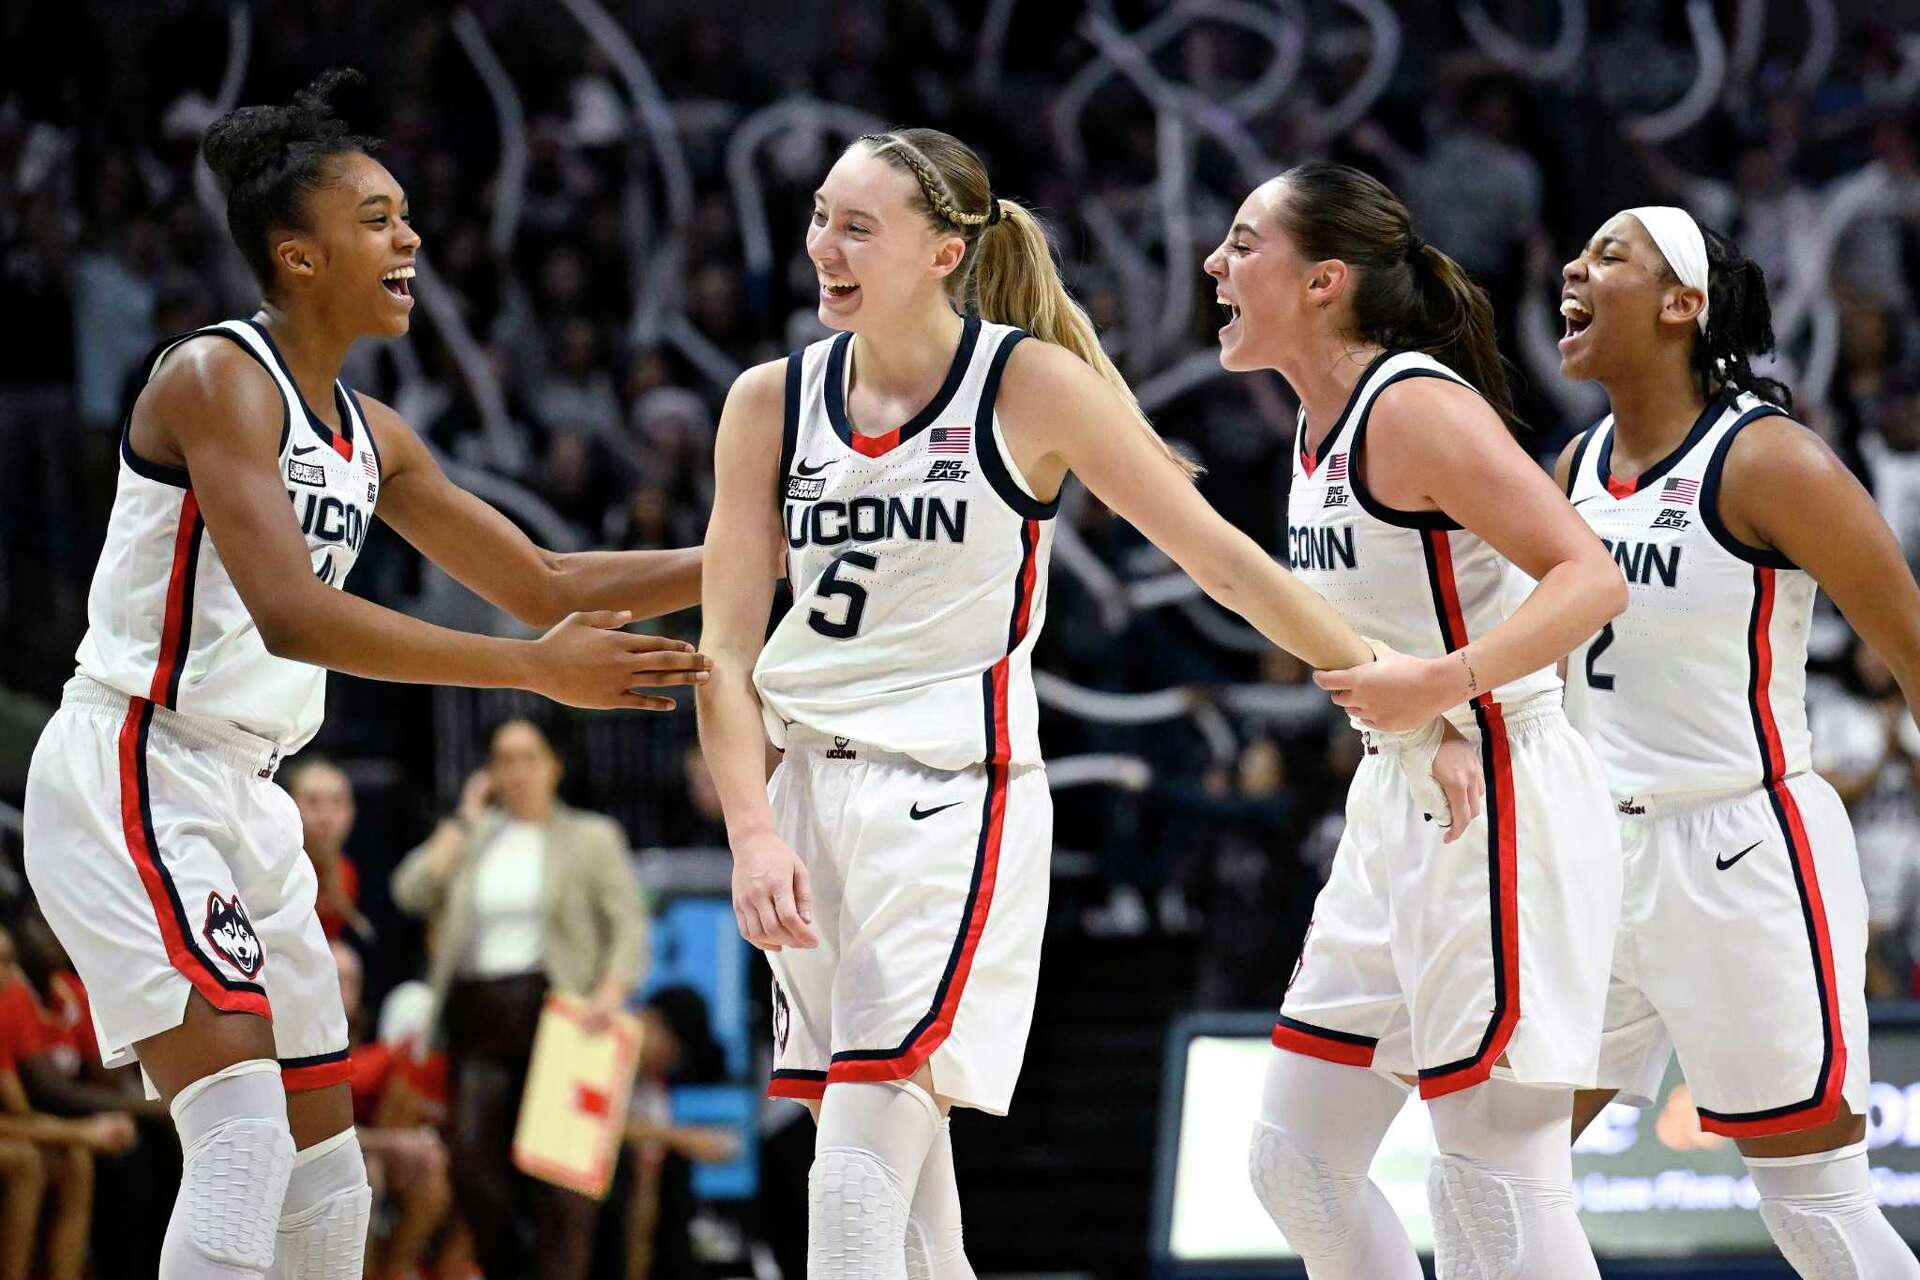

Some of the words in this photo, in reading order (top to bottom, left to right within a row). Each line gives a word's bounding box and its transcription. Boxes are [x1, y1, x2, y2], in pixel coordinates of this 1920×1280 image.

[932, 460, 963, 470] BIG
[927, 469, 971, 480] EAST
[1328, 486, 1344, 495] BIG
[1325, 494, 1350, 504] EAST
[1660, 508, 1687, 519] BIG
[786, 497, 968, 549] UCONN
[1653, 516, 1691, 528] EAST
[1289, 525, 1357, 570] CONN
[1600, 538, 1681, 588] NN
[808, 550, 879, 639] 5
[1585, 622, 1616, 692] 2
[826, 749, 857, 760] UCONN
